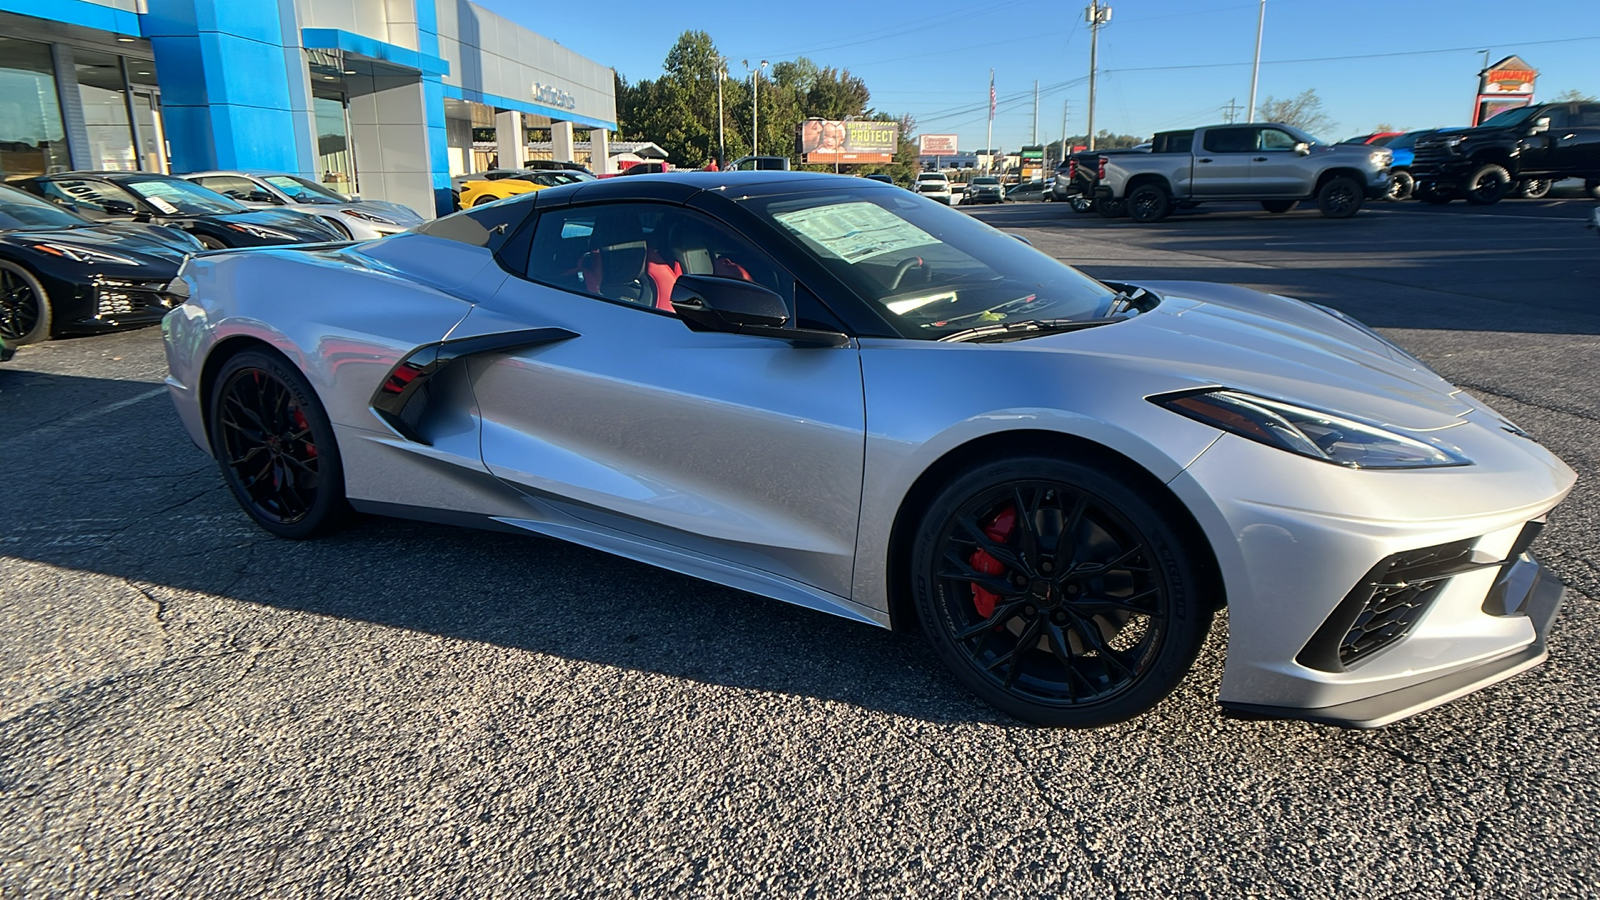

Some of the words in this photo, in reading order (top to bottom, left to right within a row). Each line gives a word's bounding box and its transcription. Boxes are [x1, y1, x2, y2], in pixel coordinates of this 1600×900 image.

[847, 122, 862, 130] DUTY
[851, 130, 894, 142] PROTECT
[1161, 547, 1185, 618] MICHELIN
[1140, 628, 1160, 666] FORGED
